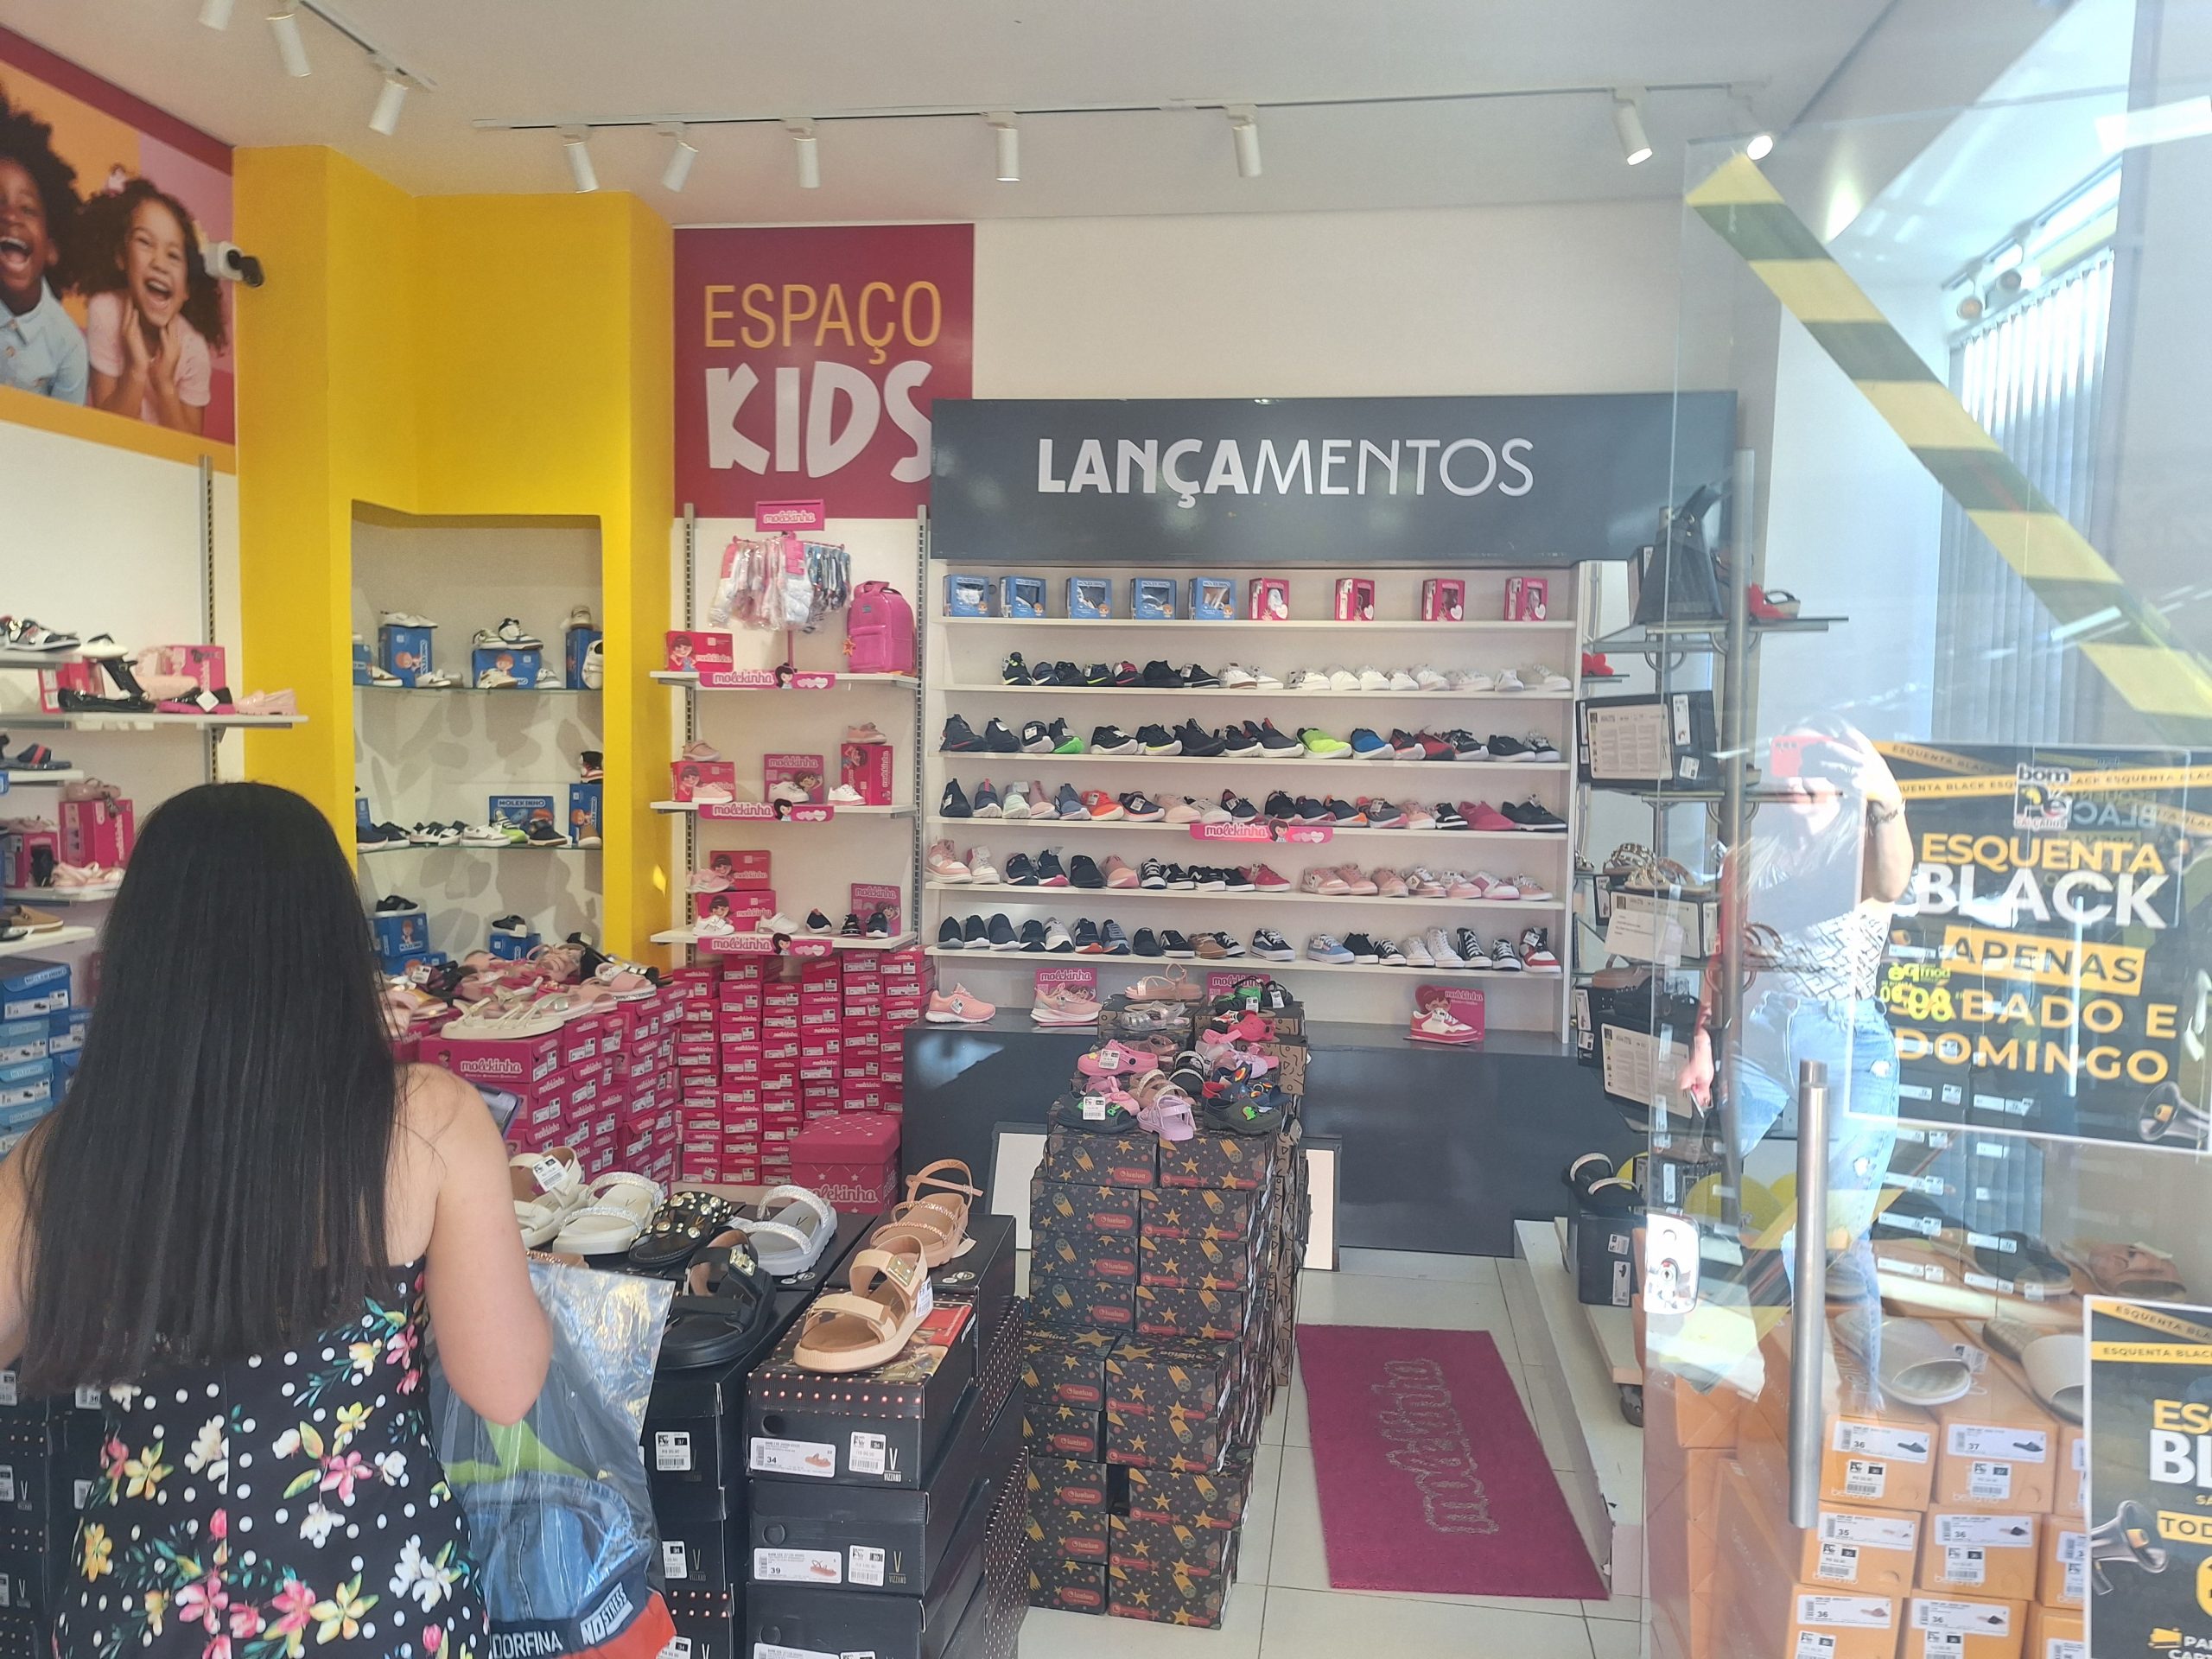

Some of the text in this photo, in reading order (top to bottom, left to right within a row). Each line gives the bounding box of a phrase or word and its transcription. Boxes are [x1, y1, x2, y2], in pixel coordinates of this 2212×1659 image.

[705, 281, 942, 365] ESPAÇO
[705, 359, 932, 484] KIDS
[1039, 436, 1535, 508] LANÇAMENTOS
[713, 671, 775, 686] molekinha
[768, 757, 818, 768] molekinha
[2018, 766, 2069, 782] bom
[1947, 782, 1979, 791] BLACK
[713, 804, 773, 817] molekinha
[1204, 823, 1268, 838] molekinha
[1923, 834, 2165, 874] ESQUENTA
[855, 887, 896, 899] molekinha
[1919, 862, 2169, 928] BLACK
[712, 938, 772, 950] molekinha
[1955, 937, 2138, 984] APENAS
[1039, 969, 1093, 983] molekinha
[2146, 1004, 2177, 1038] E
[461, 1058, 523, 1073] molekinha
[1897, 1028, 2169, 1084] DOMINGO
[810, 1184, 878, 1203] olekinha
[2115, 1306, 2183, 1330] ESQUENTA
[2103, 1347, 2171, 1357] ESQUENTA
[2153, 1399, 2212, 1435] ES
[889, 1447, 899, 1471] V
[884, 1472, 901, 1483] VIZZANO
[693, 1548, 701, 1571] V
[893, 1550, 902, 1573] V
[580, 1587, 628, 1645] NO STRESS
[492, 1630, 563, 1659] DORFINA
